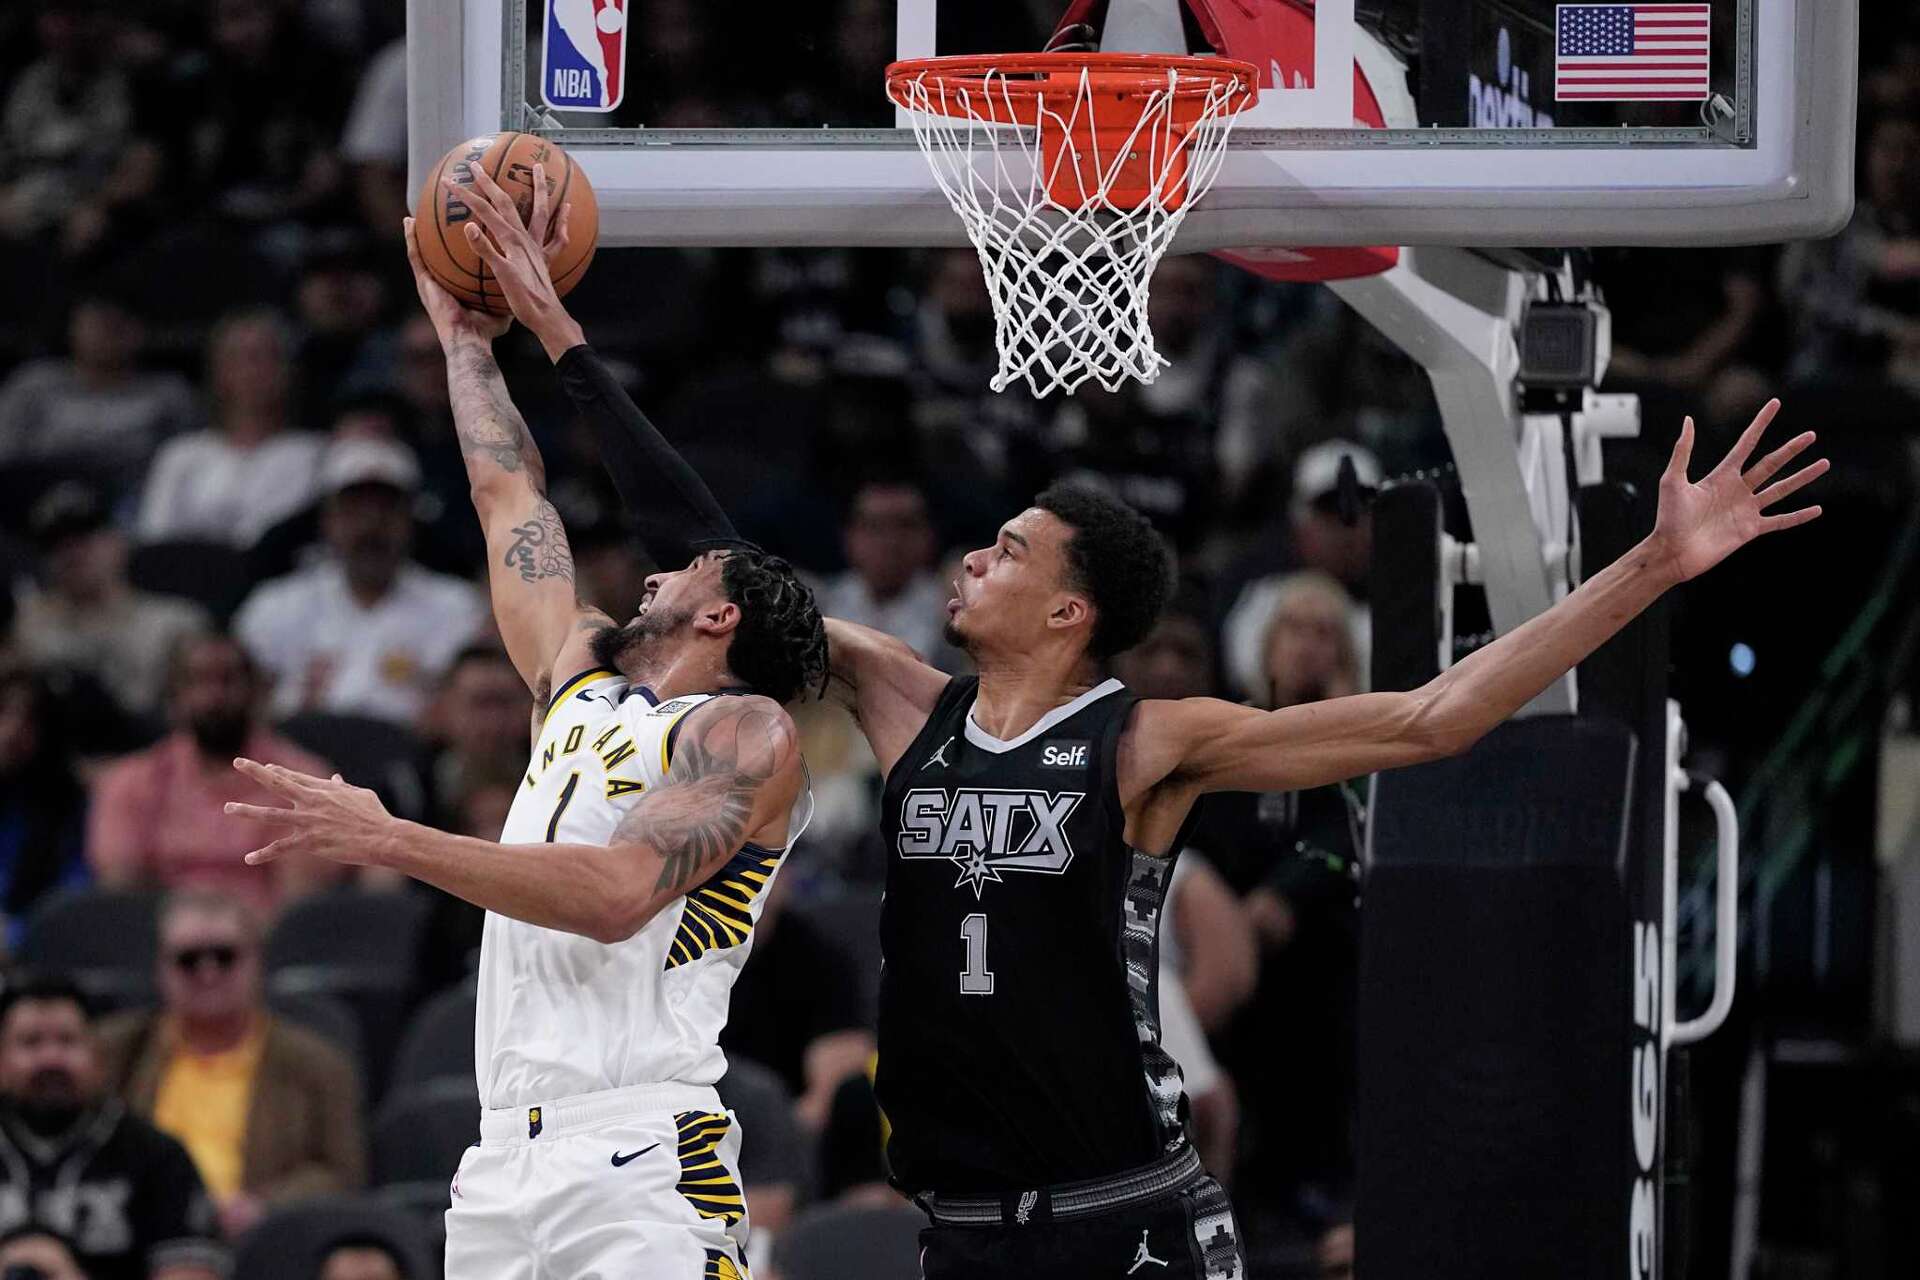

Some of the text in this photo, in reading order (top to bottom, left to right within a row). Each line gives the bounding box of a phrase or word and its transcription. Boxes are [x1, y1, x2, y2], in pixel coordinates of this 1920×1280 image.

[553, 68, 592, 99] NBA
[545, 770, 581, 843] 1
[897, 787, 1087, 875] SATX
[960, 913, 994, 995] 1
